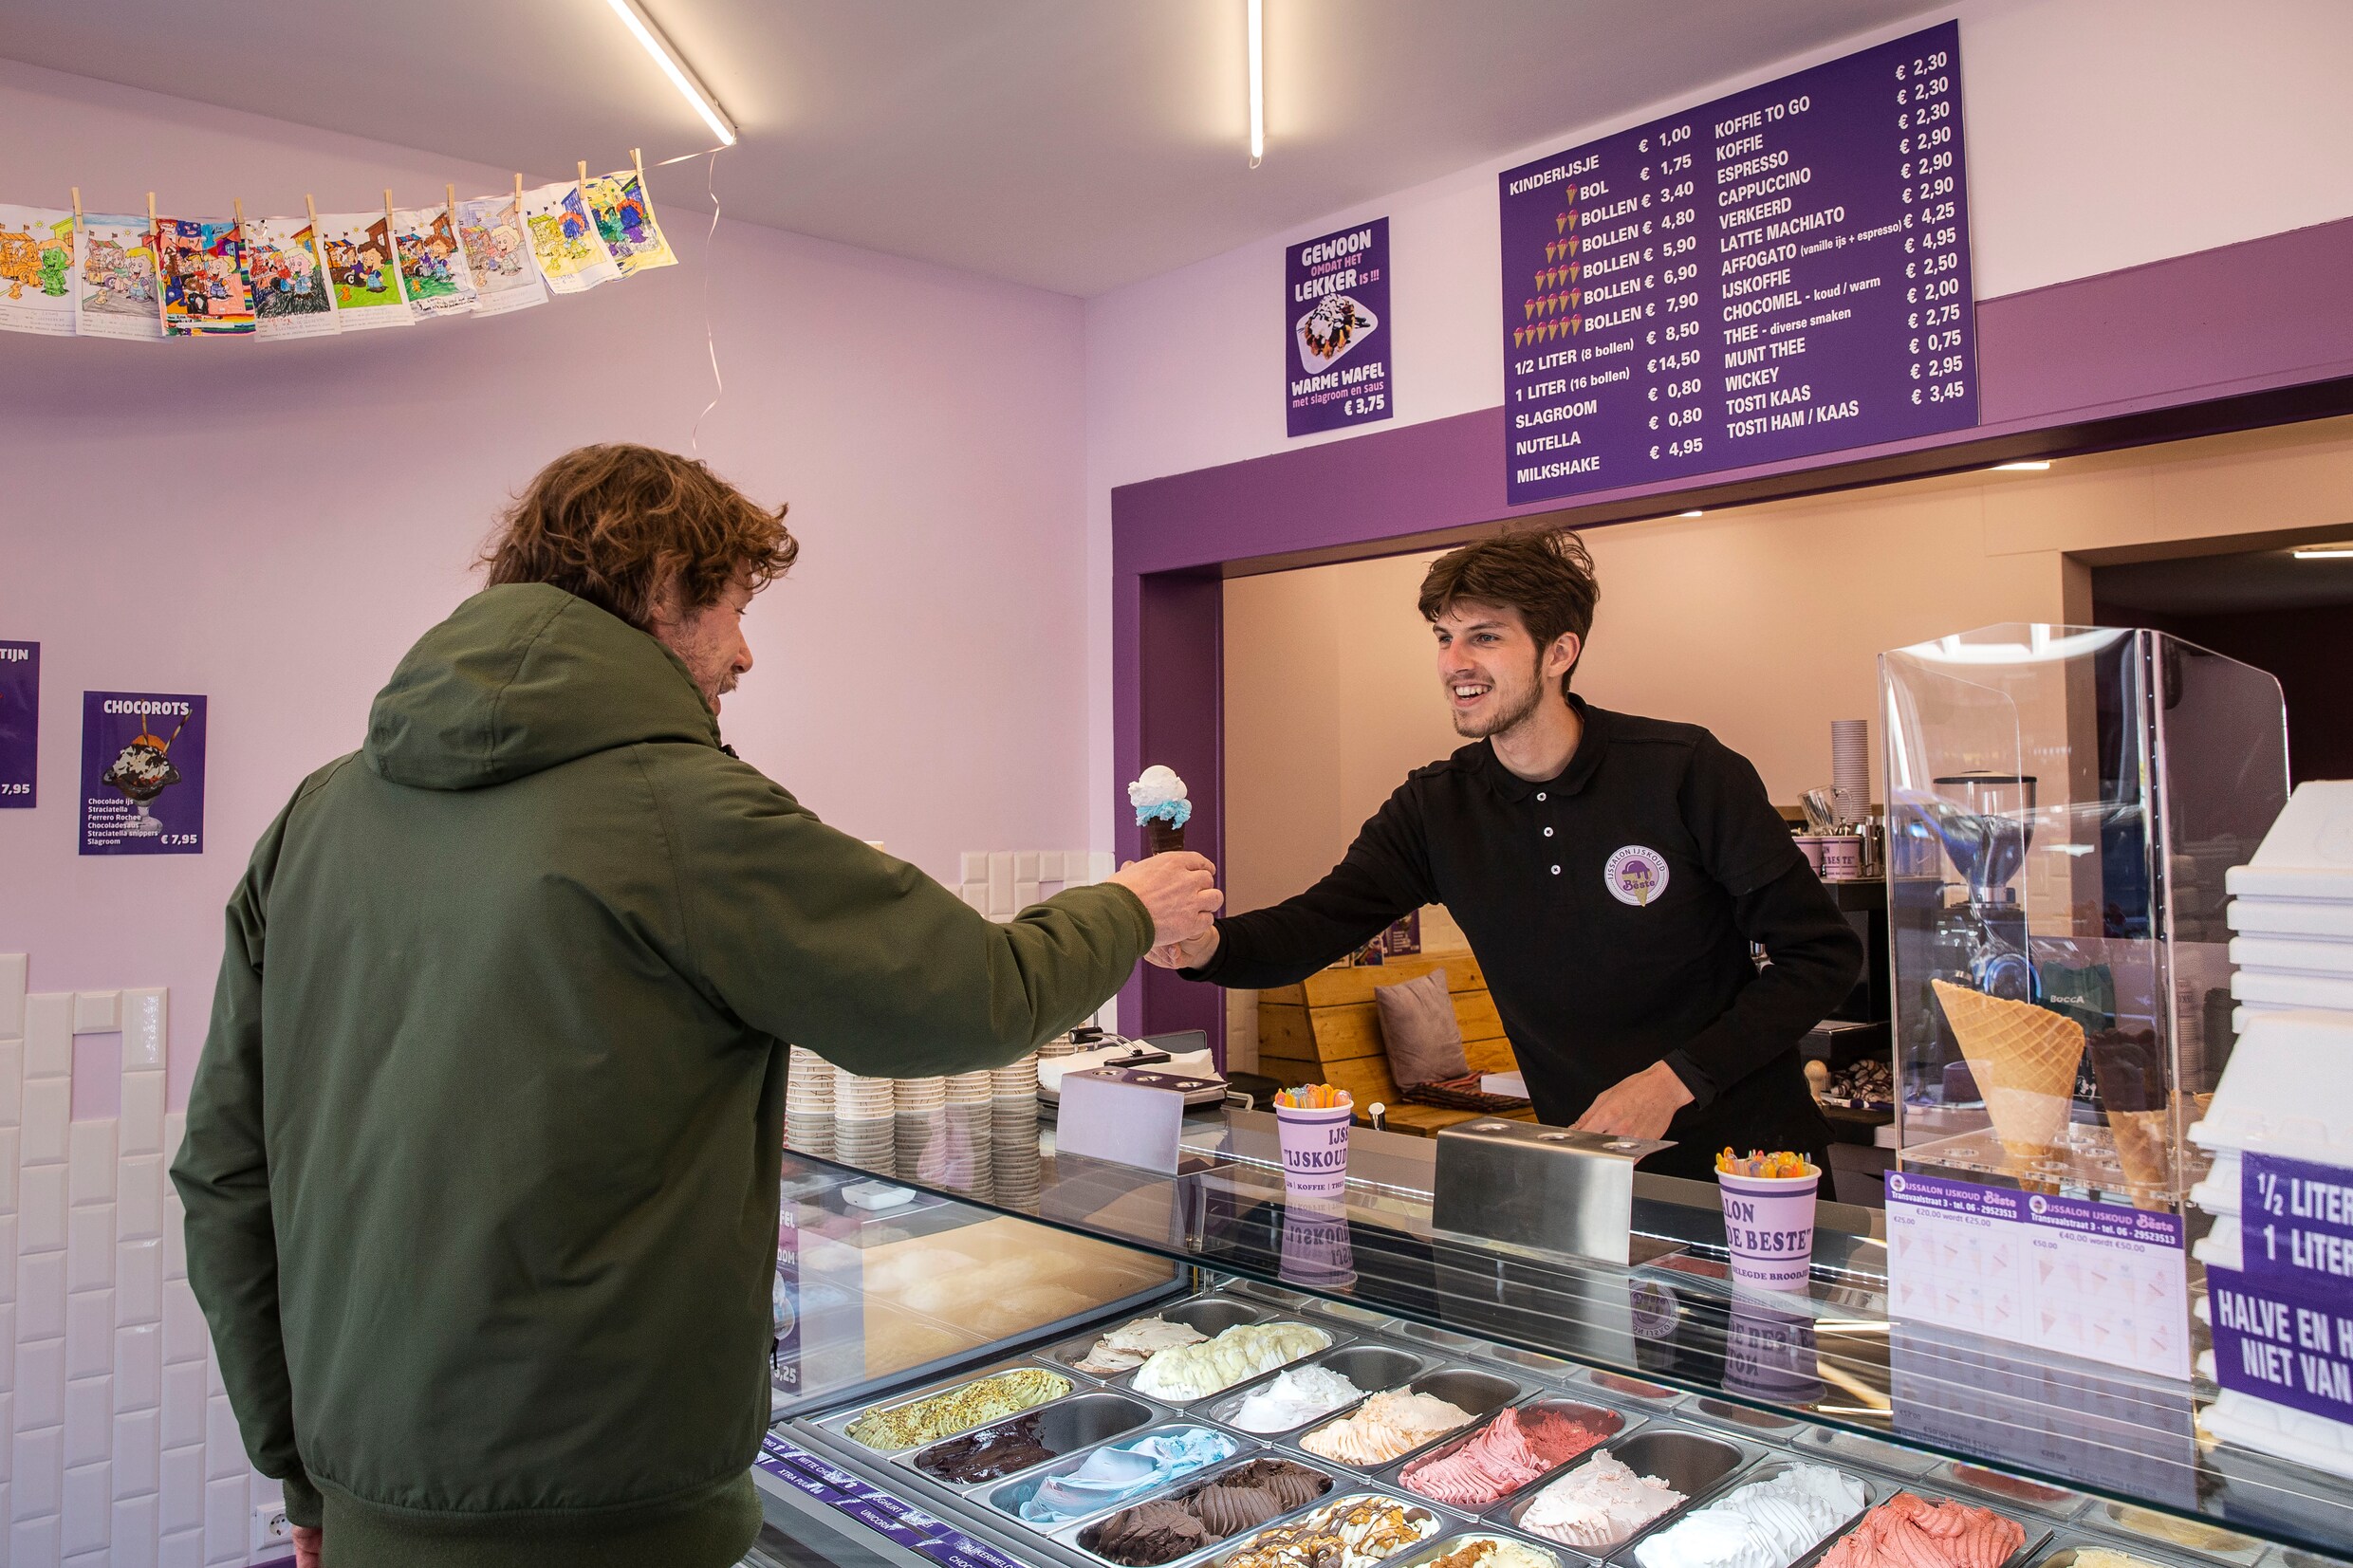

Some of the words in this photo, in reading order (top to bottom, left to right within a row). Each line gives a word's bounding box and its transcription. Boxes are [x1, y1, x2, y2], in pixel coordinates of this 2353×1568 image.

[1715, 111, 1761, 138] KOFFIE
[1765, 104, 1784, 121] TO
[1789, 97, 1809, 114] GO
[1915, 52, 1946, 75] 2,30
[1717, 135, 1763, 161] KOFFIE
[1916, 77, 1948, 100] 2,30
[1510, 155, 1599, 195] KINDERIJSJE
[1660, 125, 1691, 146] 1,00
[1717, 151, 1788, 184] ESPRESSO
[1917, 101, 1949, 124] 2,30
[1581, 181, 1608, 200] BOL
[1661, 154, 1691, 175] 1,75
[1719, 168, 1810, 206] CAPPUCCINO
[1918, 127, 1951, 149] 2,90
[1582, 197, 1637, 226] BOLLEN
[1661, 181, 1693, 202] 3,40
[1719, 197, 1791, 229] VERKEERD
[1919, 152, 1952, 175] 2,90
[1583, 224, 1638, 252] BOLLEN
[1662, 209, 1695, 230] 4,80
[1721, 229, 1763, 252] LATTE
[1767, 207, 1844, 240] MACHIATO
[1920, 176, 1953, 199] 2,90
[1302, 229, 1372, 267] GEWOON
[1584, 251, 1640, 278] BOLLEN
[1664, 236, 1695, 256] 5,90
[1722, 244, 1796, 276] AFFOGATO
[1801, 239, 1833, 256] (vanille
[1836, 236, 1846, 249] ijs
[1858, 220, 1901, 241] espresso)
[1922, 202, 1955, 224] 4,25
[1310, 258, 1343, 277] OMDAT
[1344, 252, 1362, 269] HET
[1584, 278, 1640, 304] BOLLEN
[1664, 264, 1696, 284] 6,90
[1723, 268, 1790, 299] IJSKOFFIE
[1923, 228, 1955, 249] 4,95
[1295, 268, 1358, 303] LEKKER
[1359, 273, 1369, 286] IS
[1723, 290, 1802, 322] CHOCOMEL
[1814, 284, 1841, 301] koud
[1850, 278, 1881, 292] warm
[1924, 252, 1956, 275] 2,50
[1585, 305, 1641, 332] BOLLEN
[1666, 292, 1698, 312] 7,90
[1724, 324, 1758, 344] THEE
[1770, 319, 1806, 335] diverse
[1810, 309, 1850, 325] smaken
[1925, 278, 1958, 300] 2,00
[1515, 360, 1533, 375] 1/2
[1539, 349, 1577, 370] LITER
[1582, 349, 1592, 361] (8
[1596, 338, 1634, 357] bollen)
[1666, 321, 1698, 341] 8,50
[1725, 345, 1766, 368] MUNT
[1769, 338, 1806, 359] THEE
[1926, 304, 1959, 325] 2,75
[1291, 371, 1339, 397] WARME
[1342, 361, 1384, 385] WAFEL
[1516, 389, 1522, 401] 1
[1529, 379, 1566, 399] LITER
[1571, 378, 1586, 391] (16
[1591, 367, 1629, 385] bollen)
[1659, 350, 1700, 370] 14,50
[1725, 367, 1779, 392] WICKEY
[1928, 329, 1961, 351] 0,75
[1292, 396, 1308, 409] met
[1310, 389, 1348, 407] slagroom
[1350, 385, 1362, 397] en
[1363, 380, 1384, 394] saus
[1356, 395, 1385, 415] 3,75
[1516, 400, 1597, 429] SLAGROOM
[1668, 378, 1700, 397] 0,80
[1726, 394, 1766, 415] TOSTI
[1770, 385, 1810, 406] KAAS
[1929, 355, 1962, 377] 2,95
[1727, 417, 1767, 438] TOSTI
[1771, 411, 1804, 431] HAM
[1817, 400, 1859, 422] KAAS
[1930, 381, 1964, 402] 3,45
[1517, 432, 1581, 455] NUTELLA
[1669, 408, 1702, 427] 0,80
[1518, 456, 1600, 483] MILKSHAKE
[1669, 438, 1702, 457] 4,95
[0, 648, 28, 662] TIJN
[103, 700, 190, 715] CHOCOROTS
[1, 784, 30, 796] 7,95
[125, 798, 134, 806] ijs
[87, 839, 120, 847] Slagroom
[128, 830, 158, 839] snippers
[172, 834, 197, 845] 7,95
[1607, 848, 1632, 880] IJSSALON
[1633, 848, 1666, 873] IJSKOUD
[1891, 1190, 1942, 1207] Transvaalstraat
[1943, 1199, 1949, 1208] 3
[1954, 1201, 1965, 1210] tel.
[1966, 1203, 1975, 1212] 06
[1981, 1205, 2017, 1219] 29523513
[1905, 1182, 1943, 1196] IJSSALON
[1946, 1188, 1980, 1201] IJSKOUD
[1943, 1212, 1963, 1223] wordt
[2030, 1212, 2089, 1230] Transvaalstraat
[2090, 1223, 2096, 1231] 3
[2102, 1225, 2114, 1234] tel.
[2116, 1227, 2128, 1237] 06
[2134, 1228, 2176, 1245] 29523513
[2047, 1204, 2090, 1218] IJSSALON
[2092, 1211, 2133, 1226] IJSKOUD
[2089, 1236, 2113, 1247] wordt
[2263, 1224, 2276, 1261] 1
[2217, 1288, 2292, 1343] HALVE
[2296, 1308, 2331, 1354] EN
[2241, 1337, 2293, 1388] NIET
[2299, 1353, 2353, 1405] VAN
